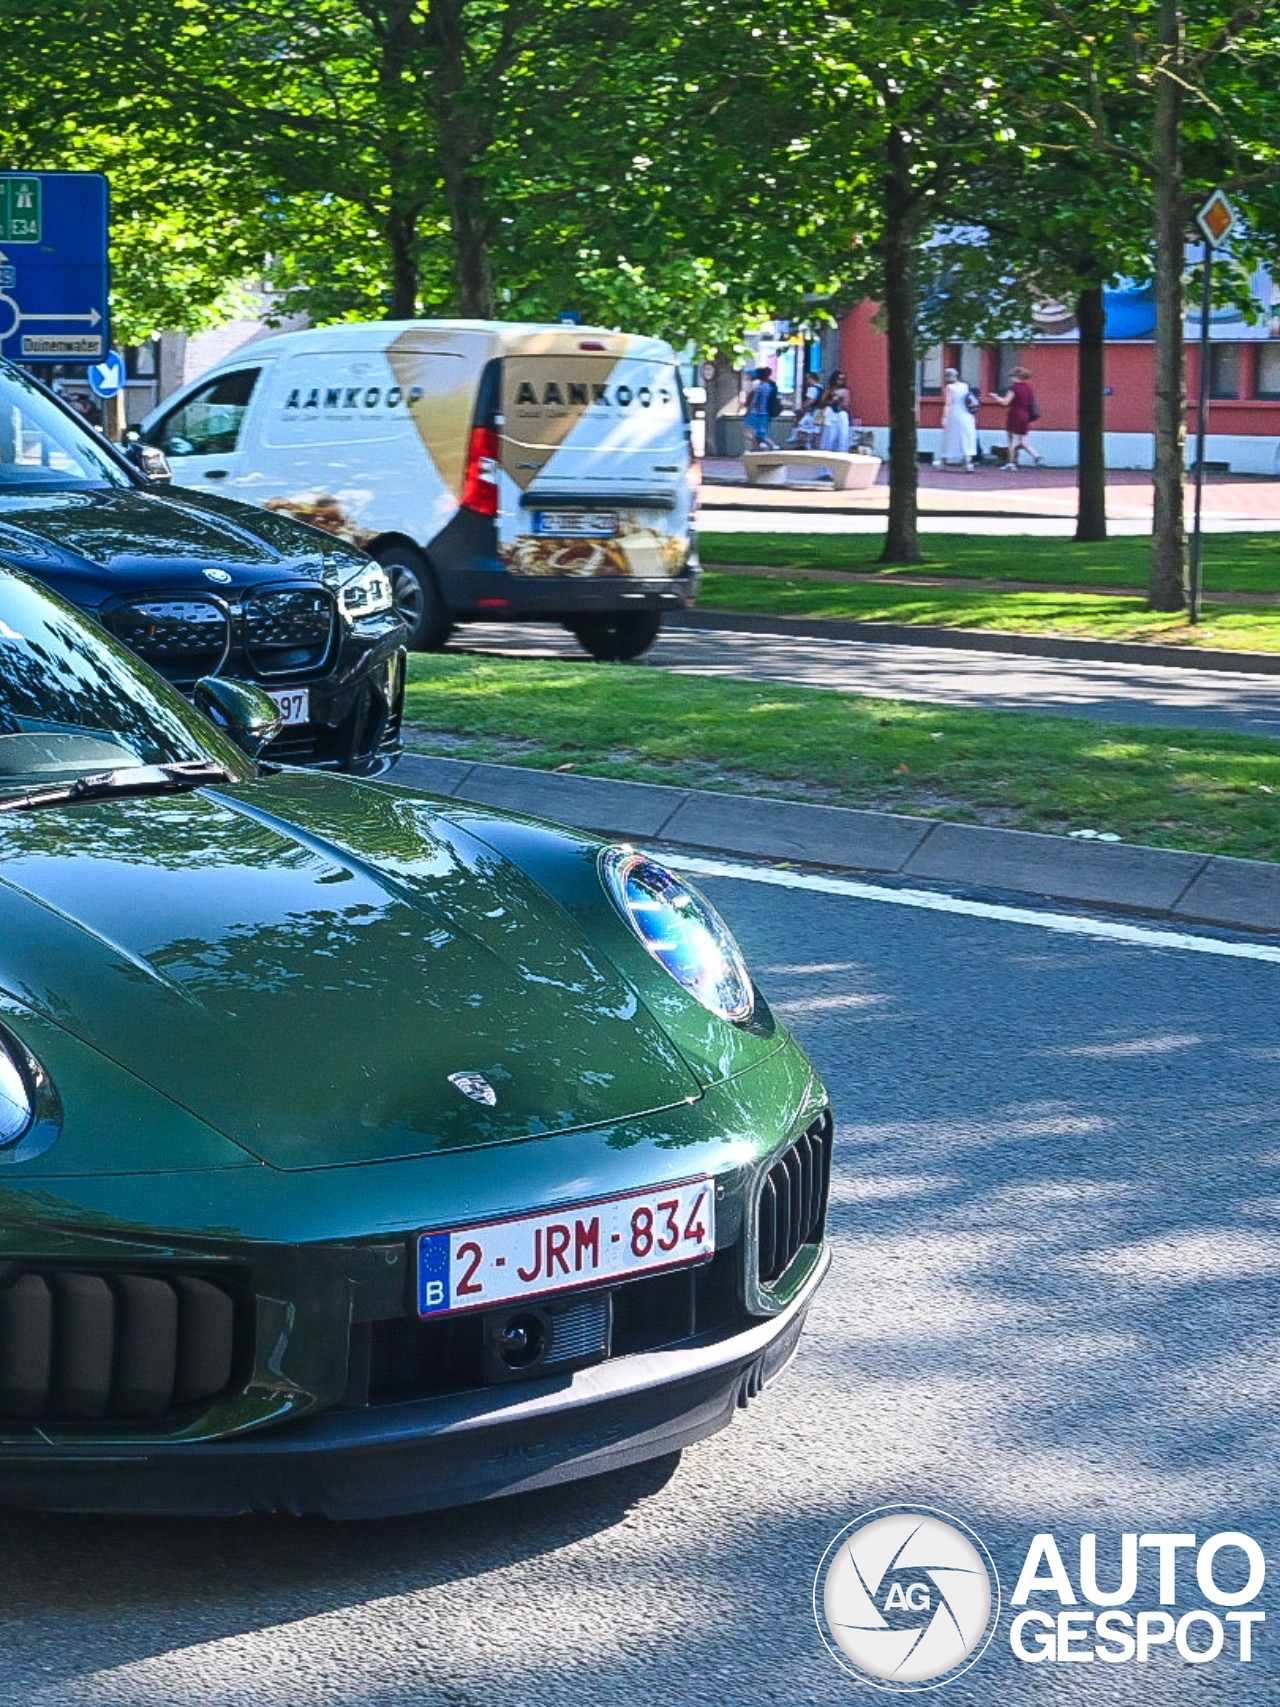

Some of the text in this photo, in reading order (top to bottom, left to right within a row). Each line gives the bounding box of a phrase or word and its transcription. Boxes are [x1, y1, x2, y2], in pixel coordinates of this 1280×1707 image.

[11, 219, 38, 235] E34
[23, 337, 99, 352] Duinenwater
[284, 386, 425, 409] AANKOOP
[515, 381, 673, 408] AANKOOP
[424, 1191, 707, 1306] B 2-JRM-834
